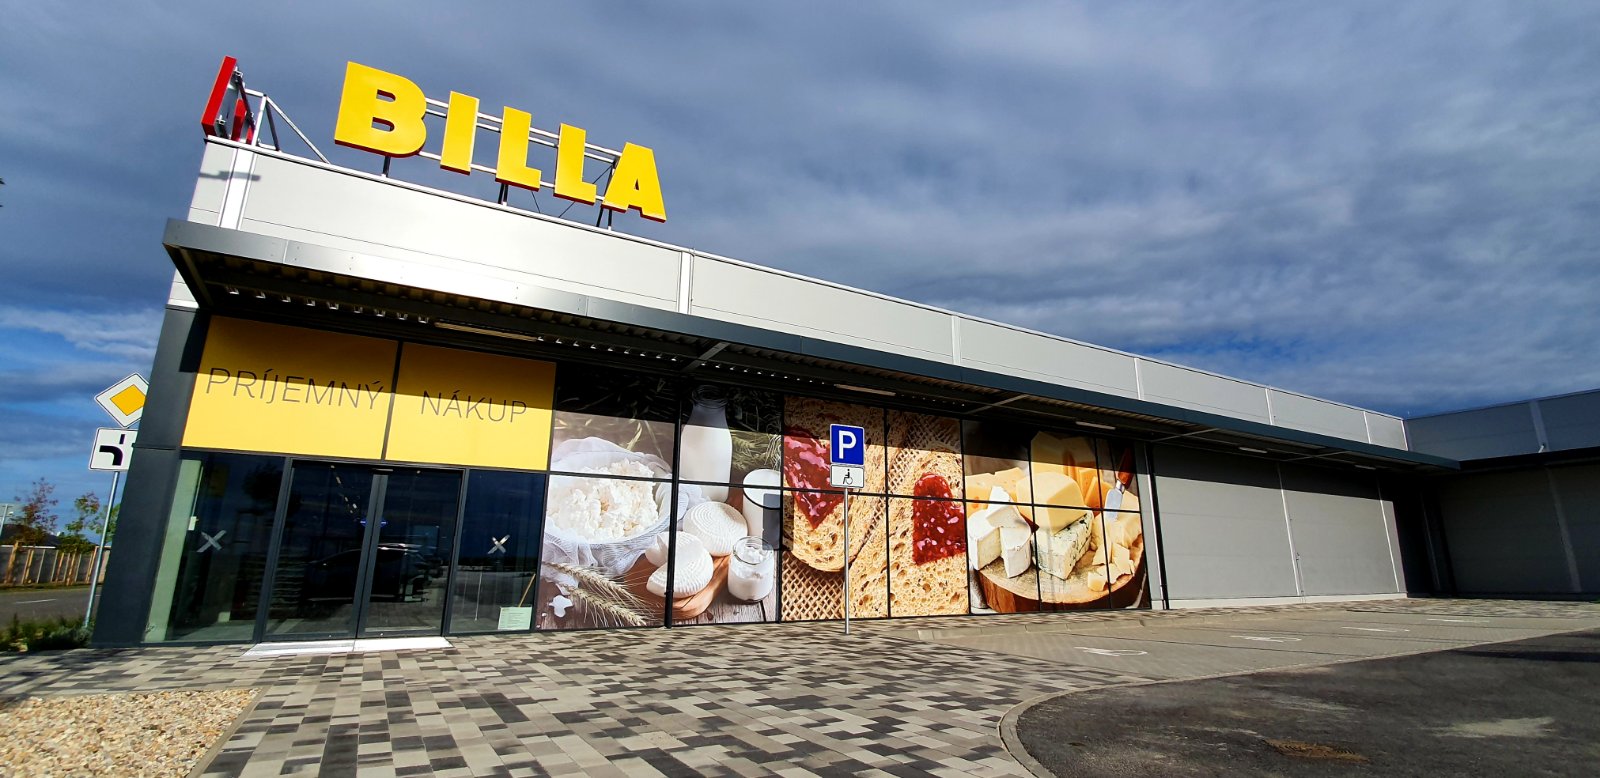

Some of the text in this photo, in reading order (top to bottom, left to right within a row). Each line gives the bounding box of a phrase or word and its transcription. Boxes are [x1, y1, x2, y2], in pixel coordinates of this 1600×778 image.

[334, 61, 667, 222] BILLA
[205, 367, 528, 423] PRÍJEMNÝ NÁKUP
[838, 430, 857, 460] P
